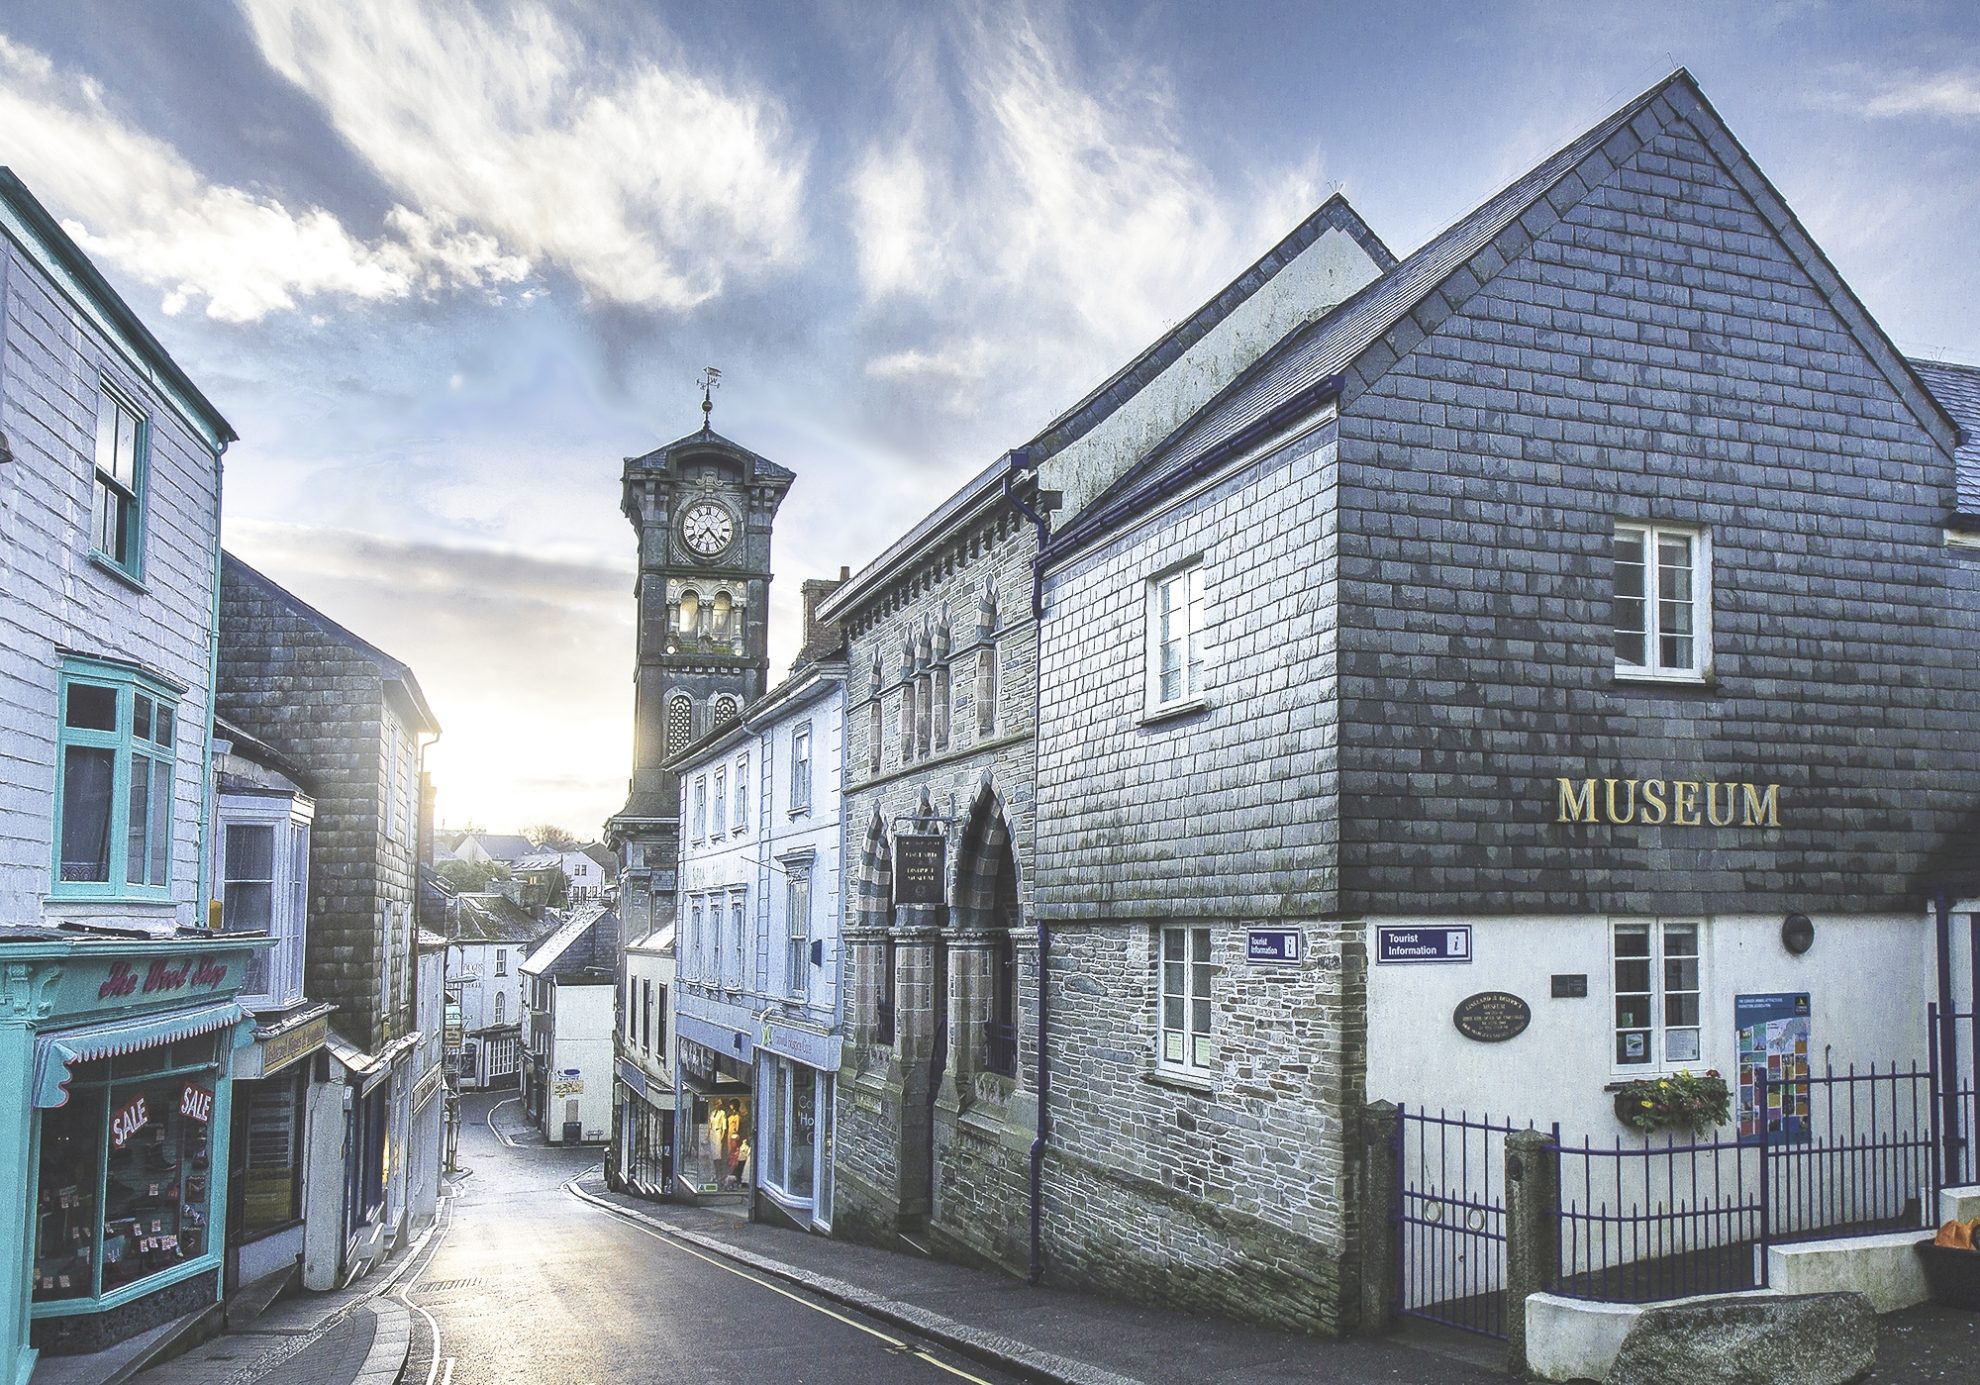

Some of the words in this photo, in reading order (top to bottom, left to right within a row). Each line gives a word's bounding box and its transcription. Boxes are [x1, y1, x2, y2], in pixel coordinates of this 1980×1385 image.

[1555, 777, 1782, 827] MUSEUM
[1251, 936, 1268, 946] Tourist
[1388, 933, 1418, 943] Tourist
[1250, 945, 1278, 955] Information
[1388, 945, 1437, 956] Information
[98, 960, 139, 1000] The
[190, 954, 228, 992] Shop
[181, 1087, 212, 1121] SALE
[113, 1097, 148, 1145] SALE
